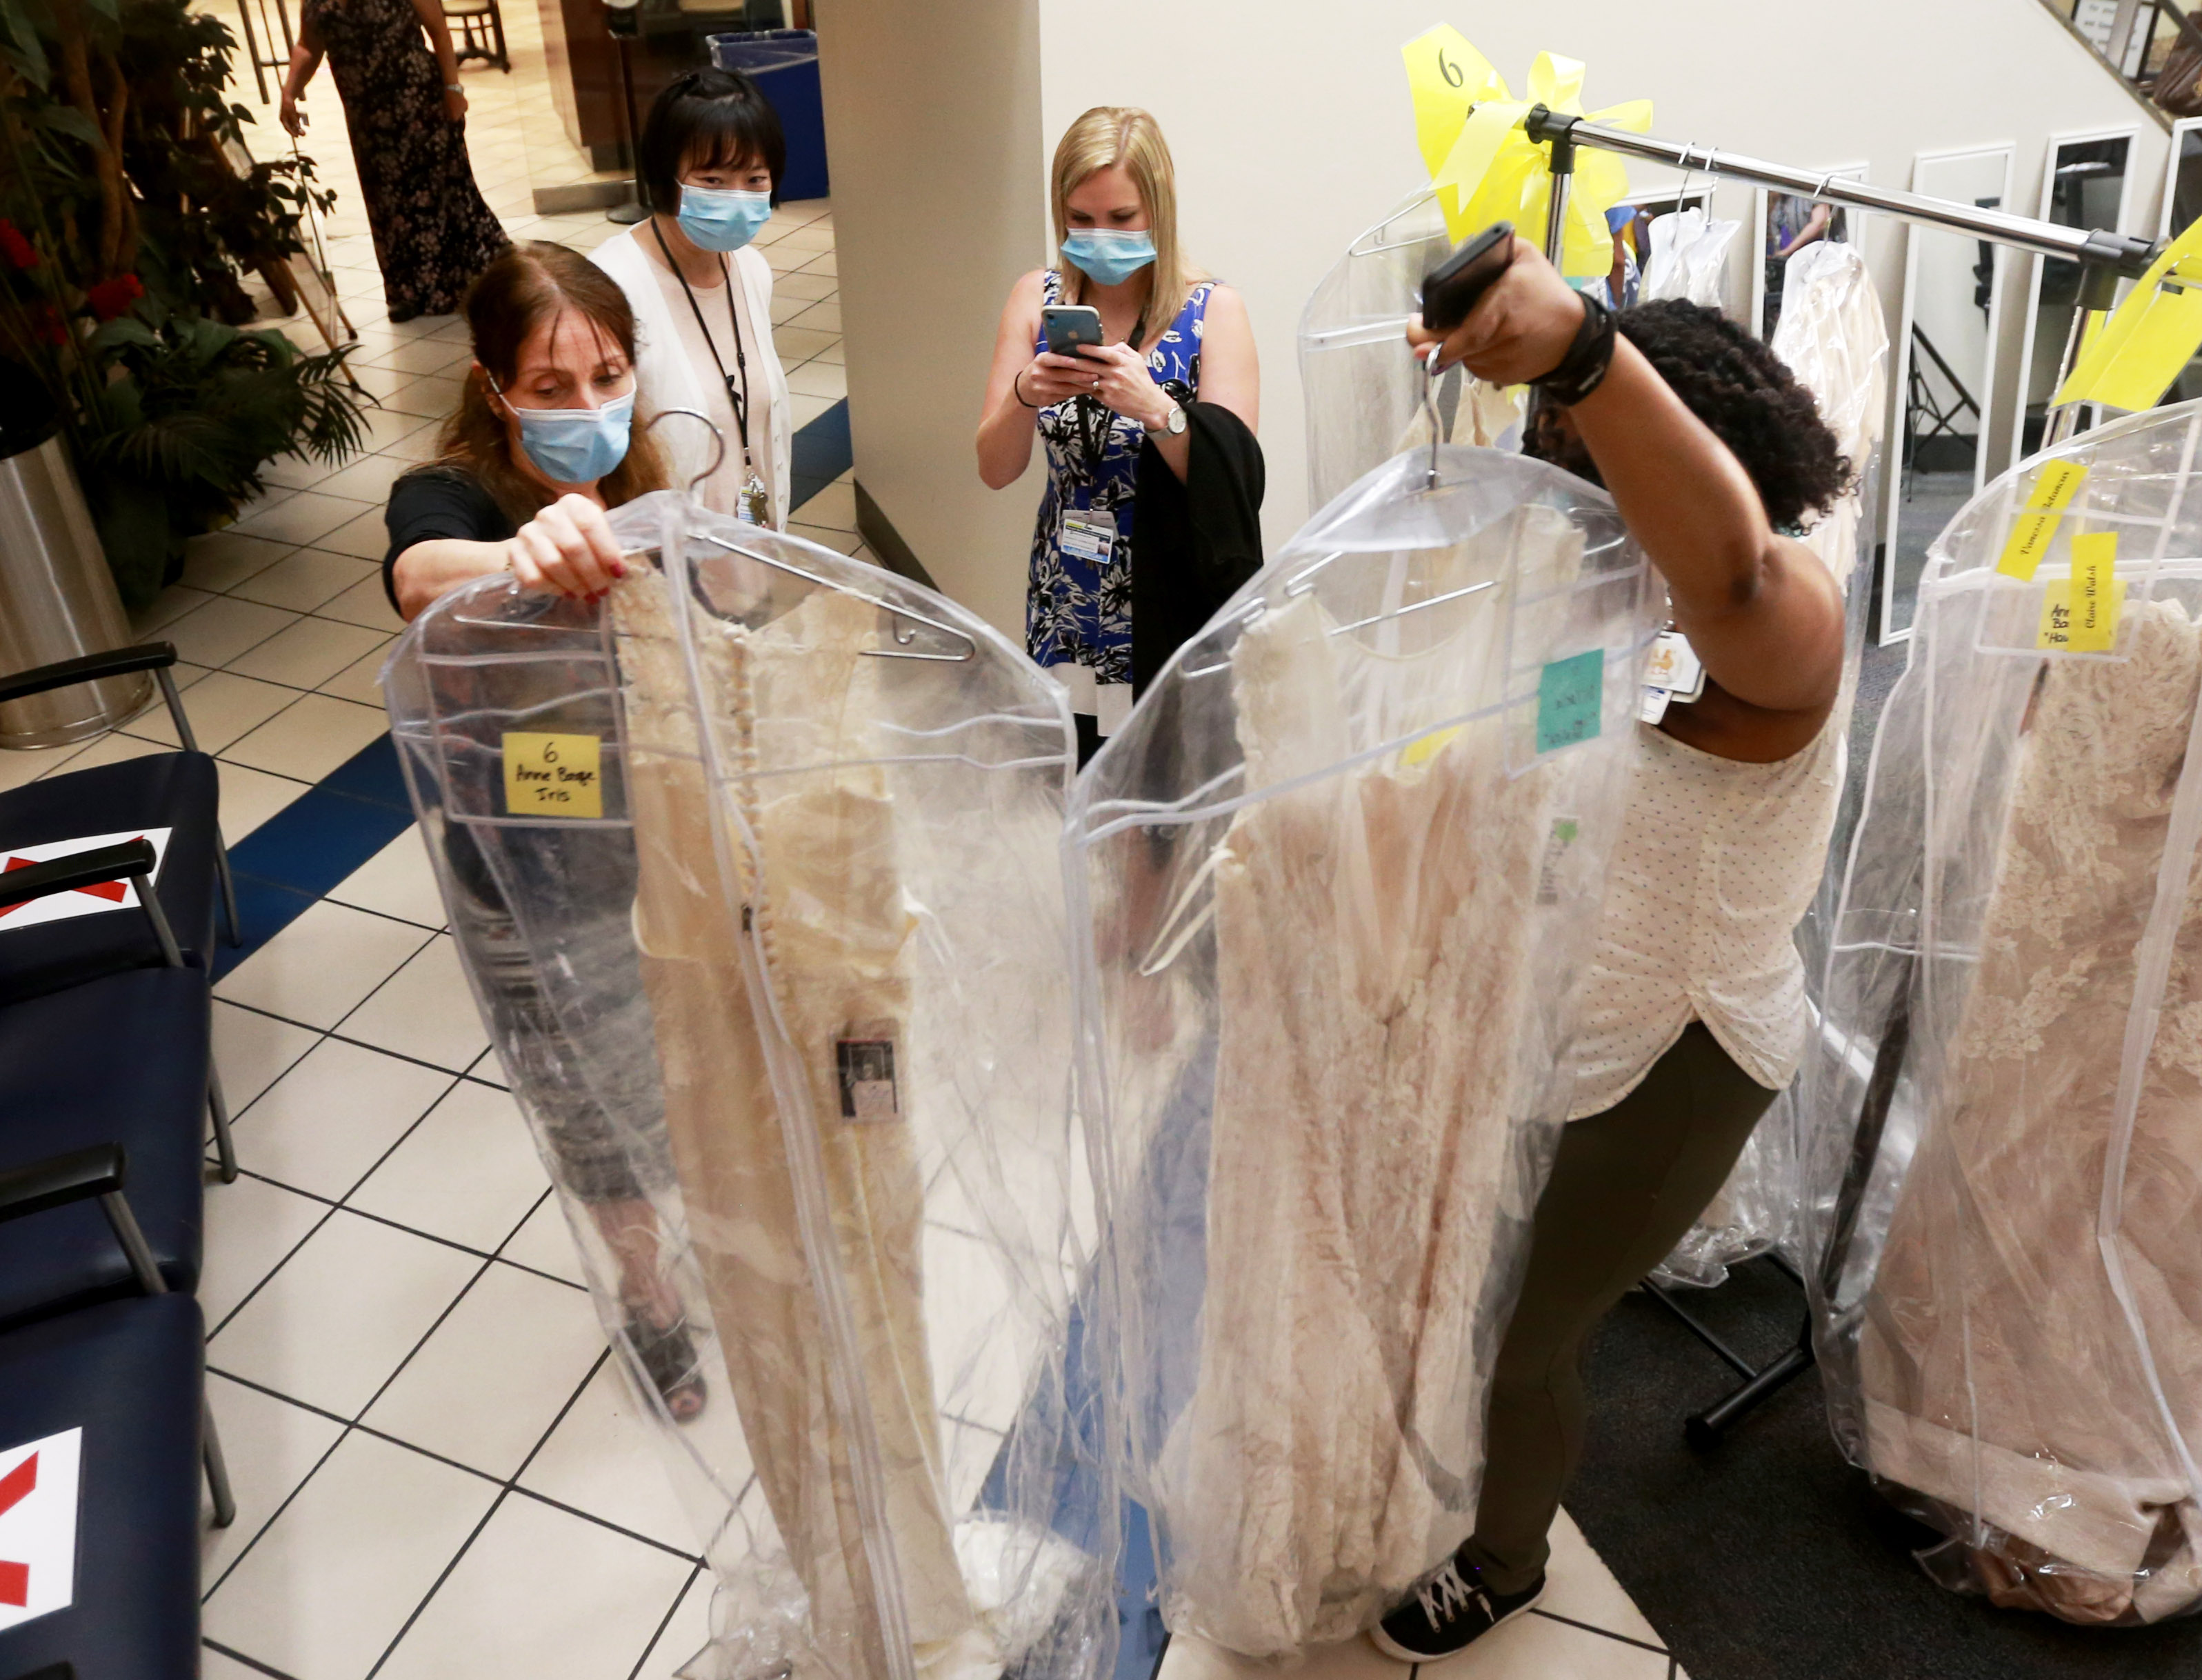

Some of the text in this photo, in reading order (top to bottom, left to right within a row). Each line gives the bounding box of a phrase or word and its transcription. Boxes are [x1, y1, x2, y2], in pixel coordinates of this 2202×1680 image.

[1439, 47, 1463, 88] 6
[2019, 516, 2047, 554] Vanessa
[2085, 565, 2097, 628] Claire Walsh
[543, 741, 559, 763] 6
[516, 764, 551, 781] Anne
[534, 787, 571, 802] Iris
